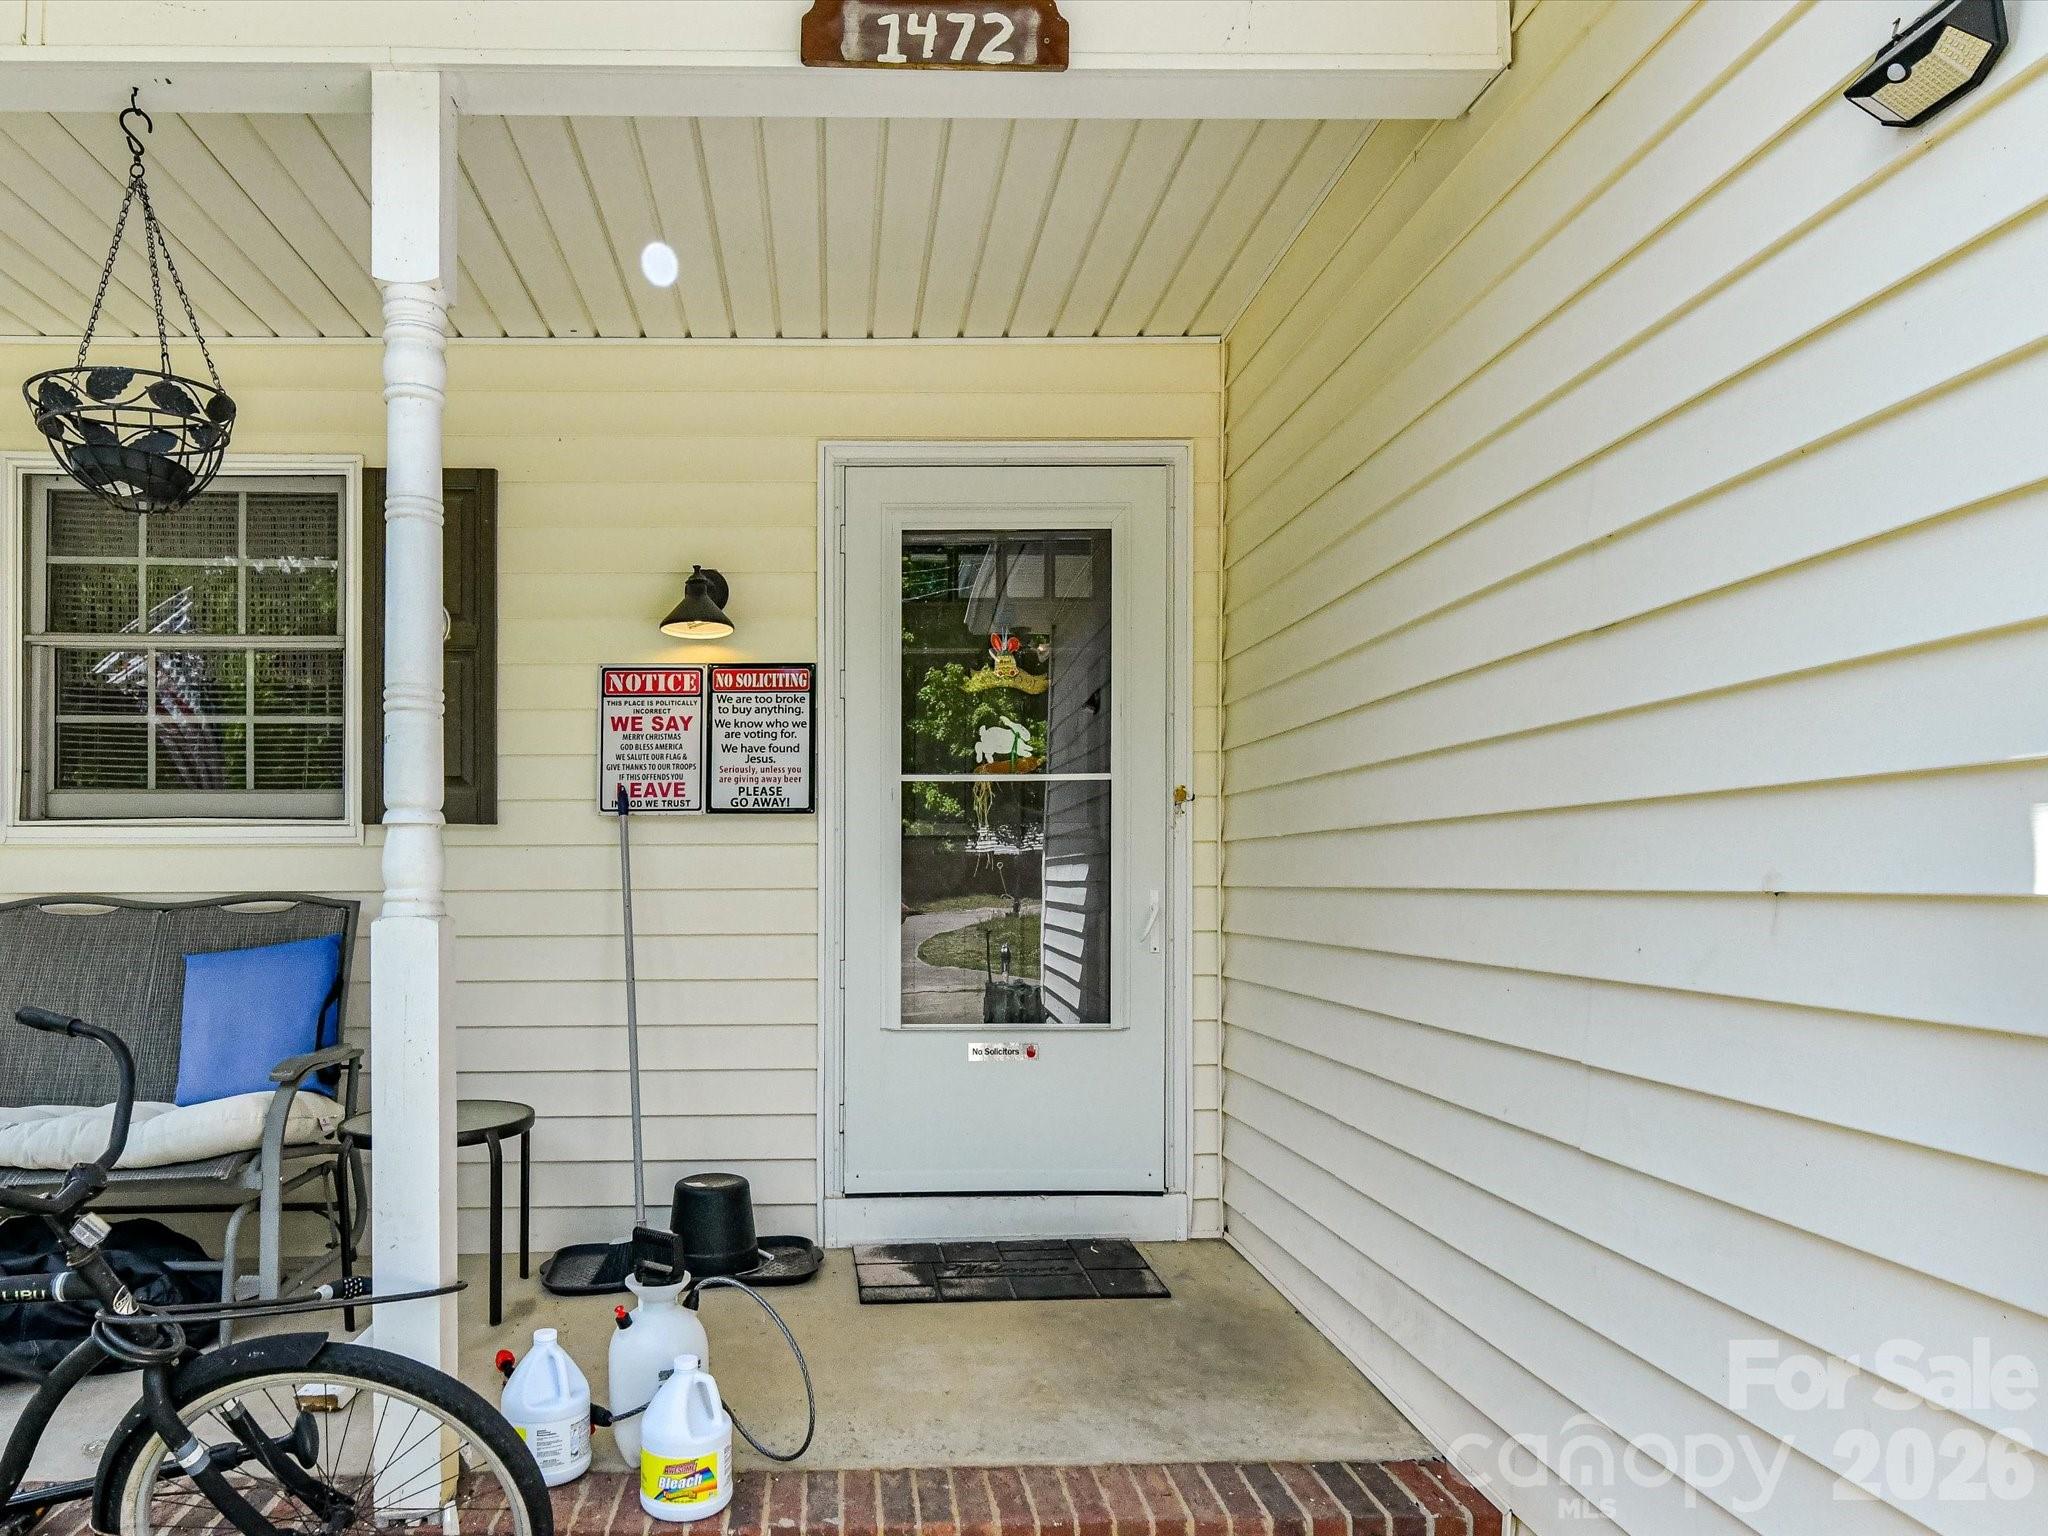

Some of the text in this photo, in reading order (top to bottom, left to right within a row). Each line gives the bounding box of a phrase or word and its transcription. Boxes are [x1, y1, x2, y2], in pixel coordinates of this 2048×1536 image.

[877, 12, 1014, 63] 1472
[608, 673, 697, 692] NOTICE
[715, 672, 808, 688] NO SOLICITING
[716, 694, 806, 704] We are too broke
[718, 705, 804, 716] to buy anything.
[610, 716, 693, 732] WE SAY
[714, 719, 731, 729] We
[733, 719, 763, 728] know
[765, 719, 789, 728] who
[724, 729, 797, 741] are voting for.
[721, 744, 800, 753] We have found
[744, 754, 776, 764] Jesus.
[719, 766, 758, 775] Seriously,
[760, 766, 786, 774] unless
[733, 776, 759, 785] giving
[761, 776, 782, 785] away
[783, 775, 802, 783] beer
[617, 782, 686, 798] EAVE
[738, 786, 783, 796] PLEASE
[730, 798, 790, 808] GO AWAY!
[984, 1048, 1020, 1056] Solicitors
[658, 1474, 703, 1490] Bleach
